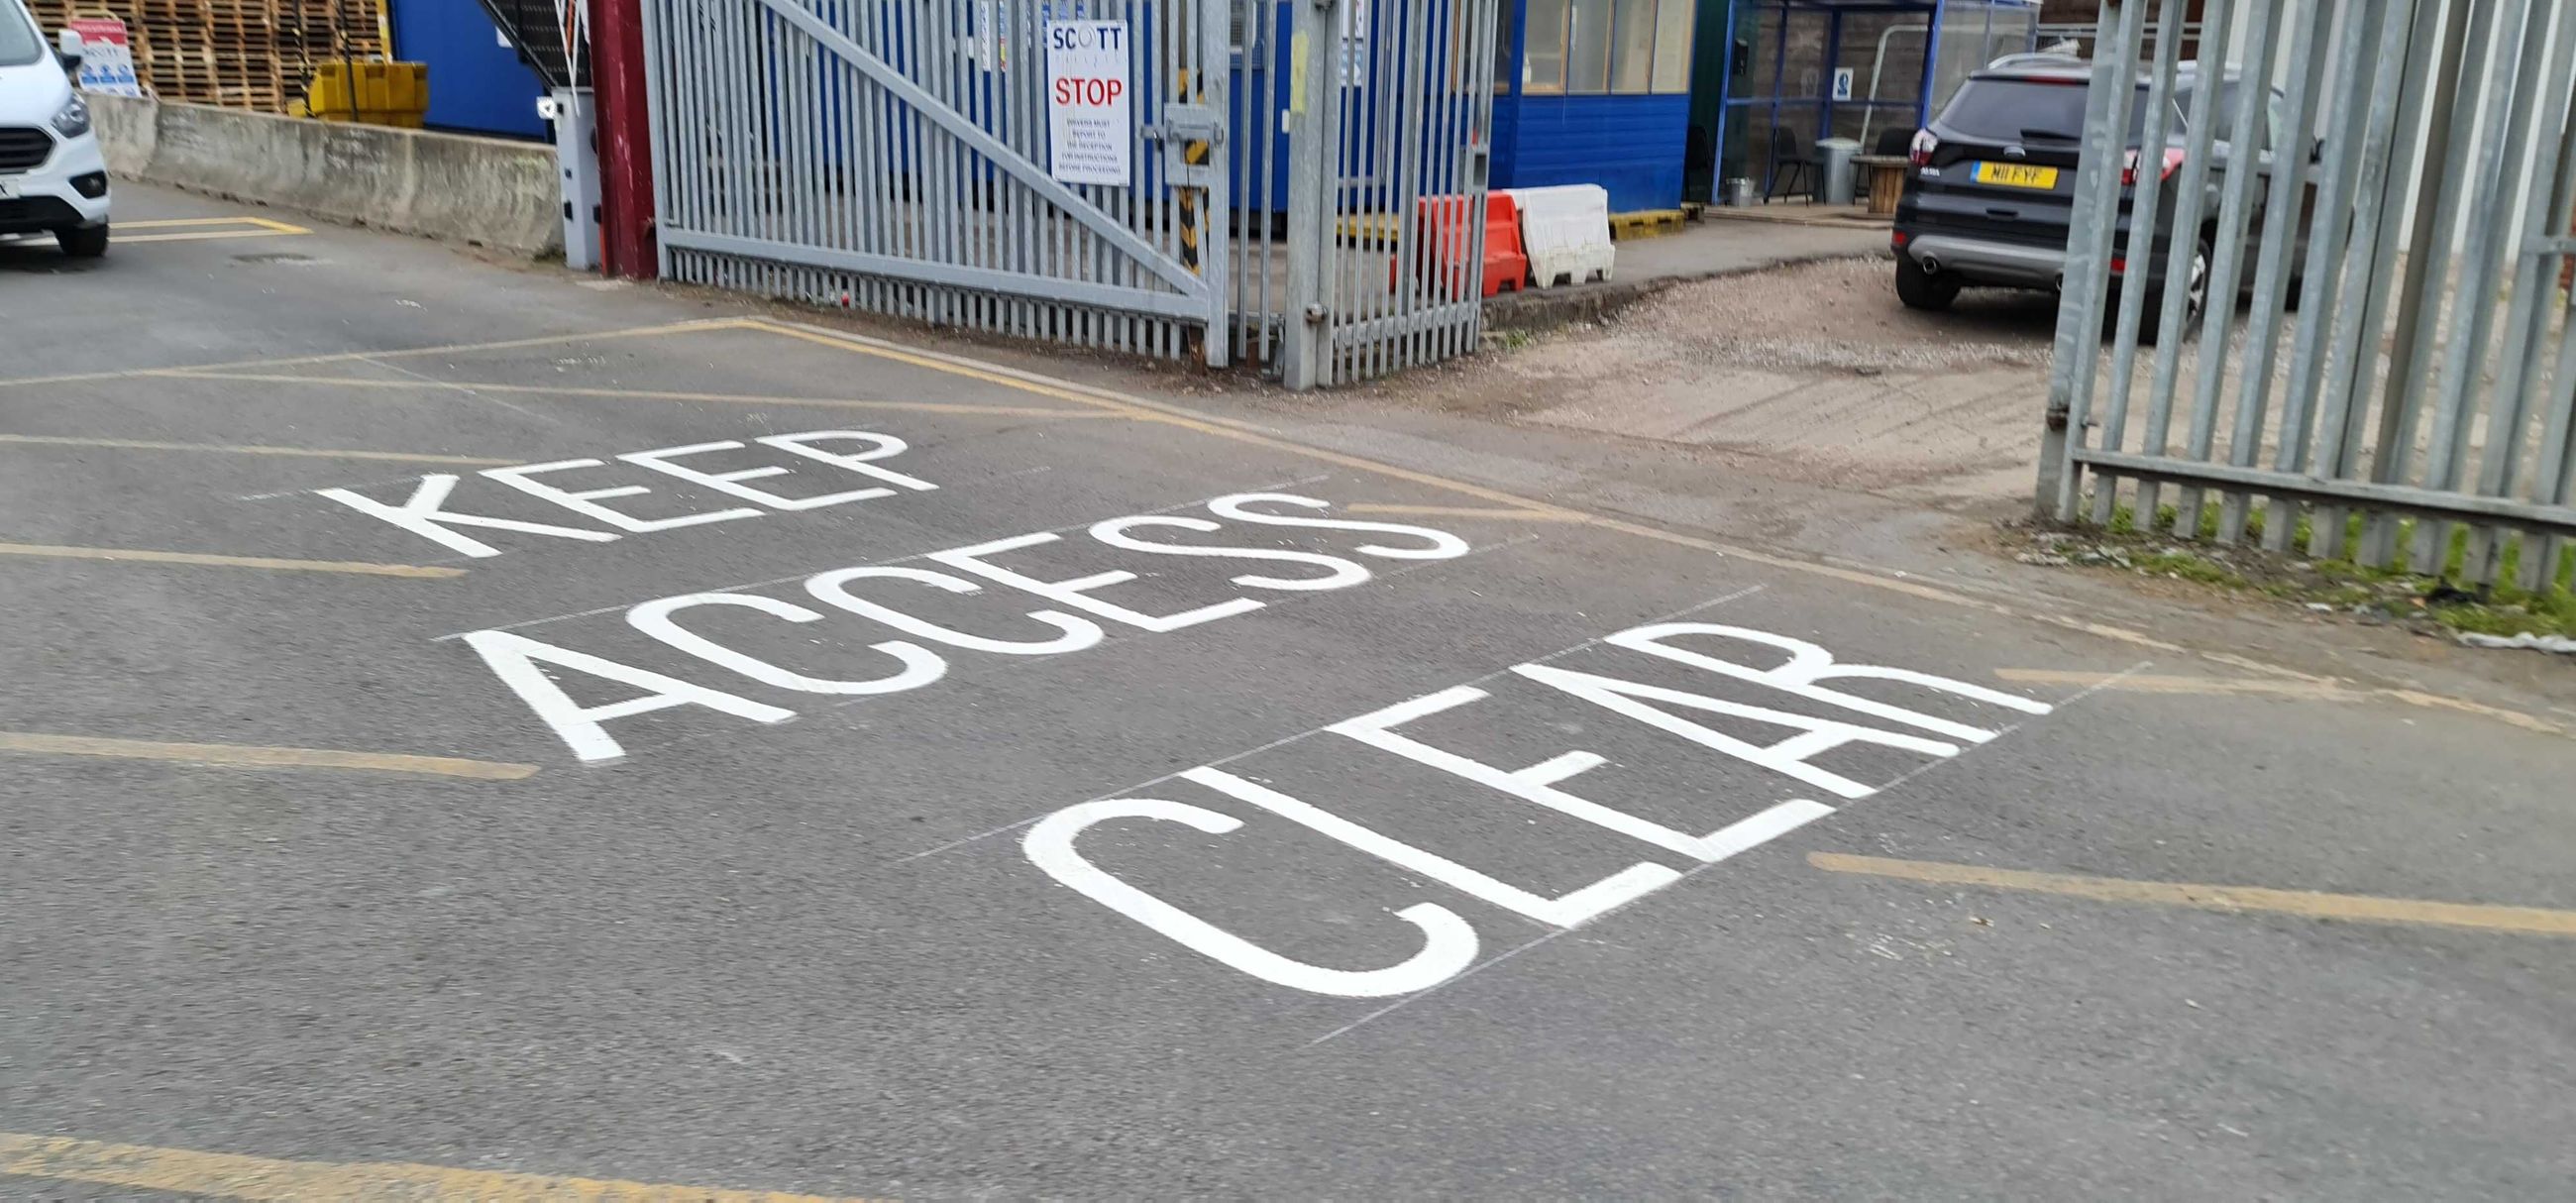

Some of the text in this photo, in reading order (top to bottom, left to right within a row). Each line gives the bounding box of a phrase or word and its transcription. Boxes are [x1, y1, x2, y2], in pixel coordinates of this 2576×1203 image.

[1053, 27, 1122, 50] SCOTT
[1055, 77, 1123, 106] STOP
[316, 430, 939, 558] KEEP
[460, 492, 1470, 764] ACCESS
[1021, 621, 2054, 998] CLEAR
